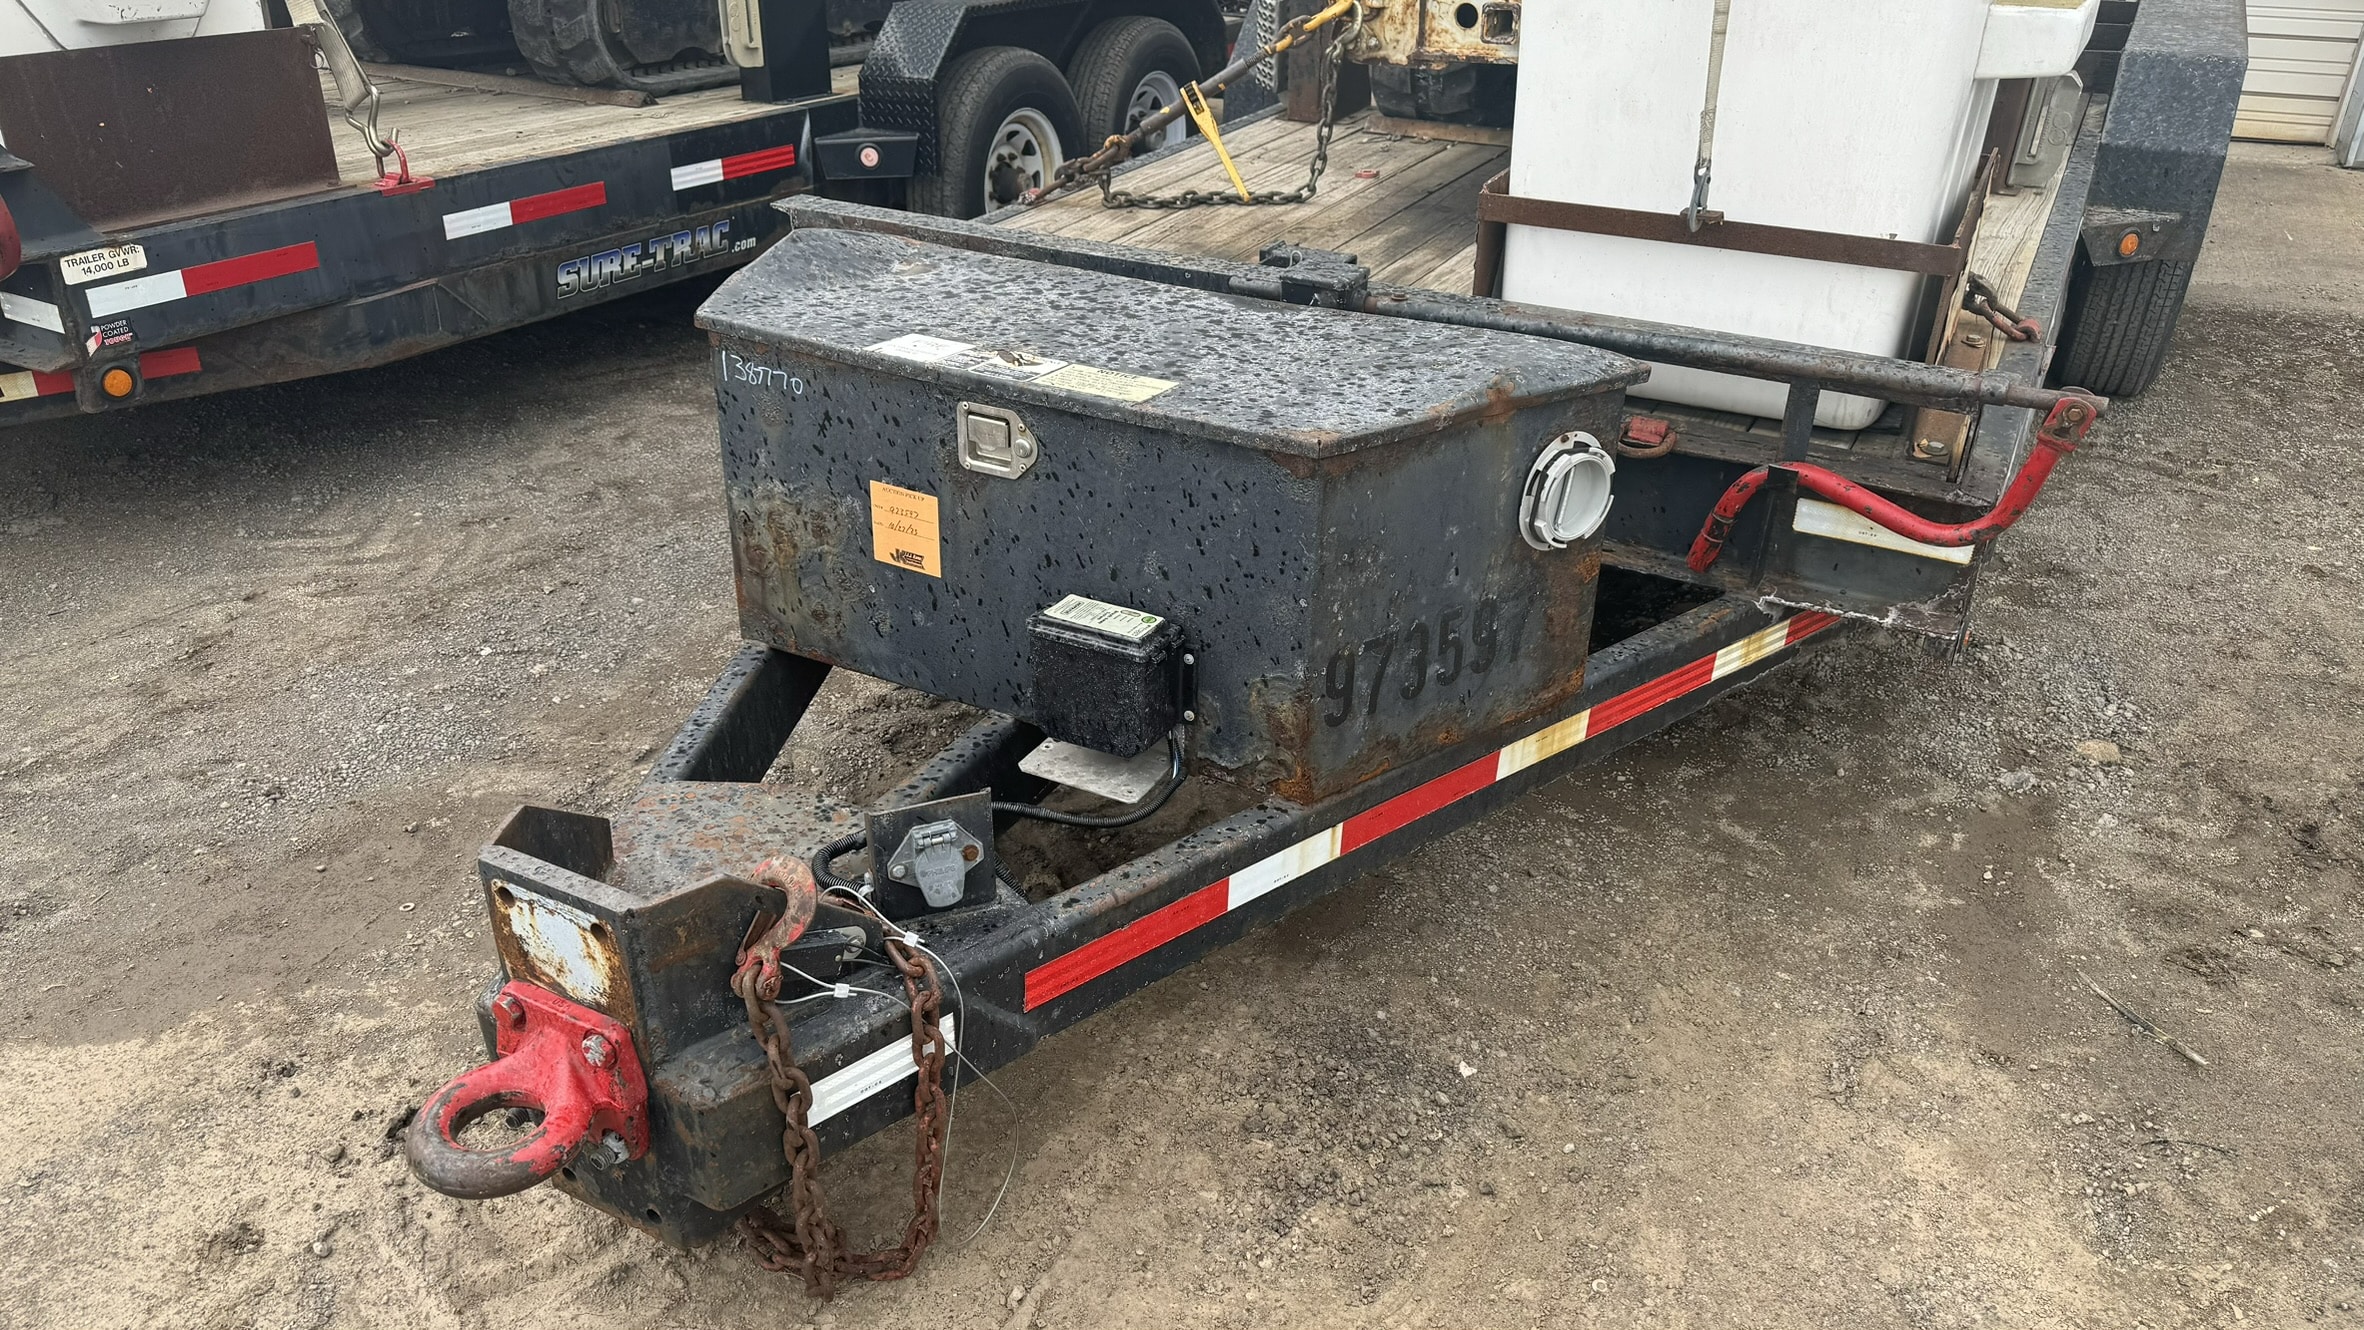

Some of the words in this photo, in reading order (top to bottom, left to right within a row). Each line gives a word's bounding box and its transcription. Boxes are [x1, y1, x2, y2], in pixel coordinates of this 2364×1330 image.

[64, 252, 106, 268] TRAILER
[108, 245, 140, 259] GVWR:
[557, 219, 731, 299] SURE-TRAC
[731, 236, 756, 253] .com
[82, 261, 114, 276] 14,000
[117, 258, 130, 267] LB
[100, 320, 127, 331] POWDER
[102, 326, 129, 338] COATED
[1324, 590, 1533, 728] 973597
